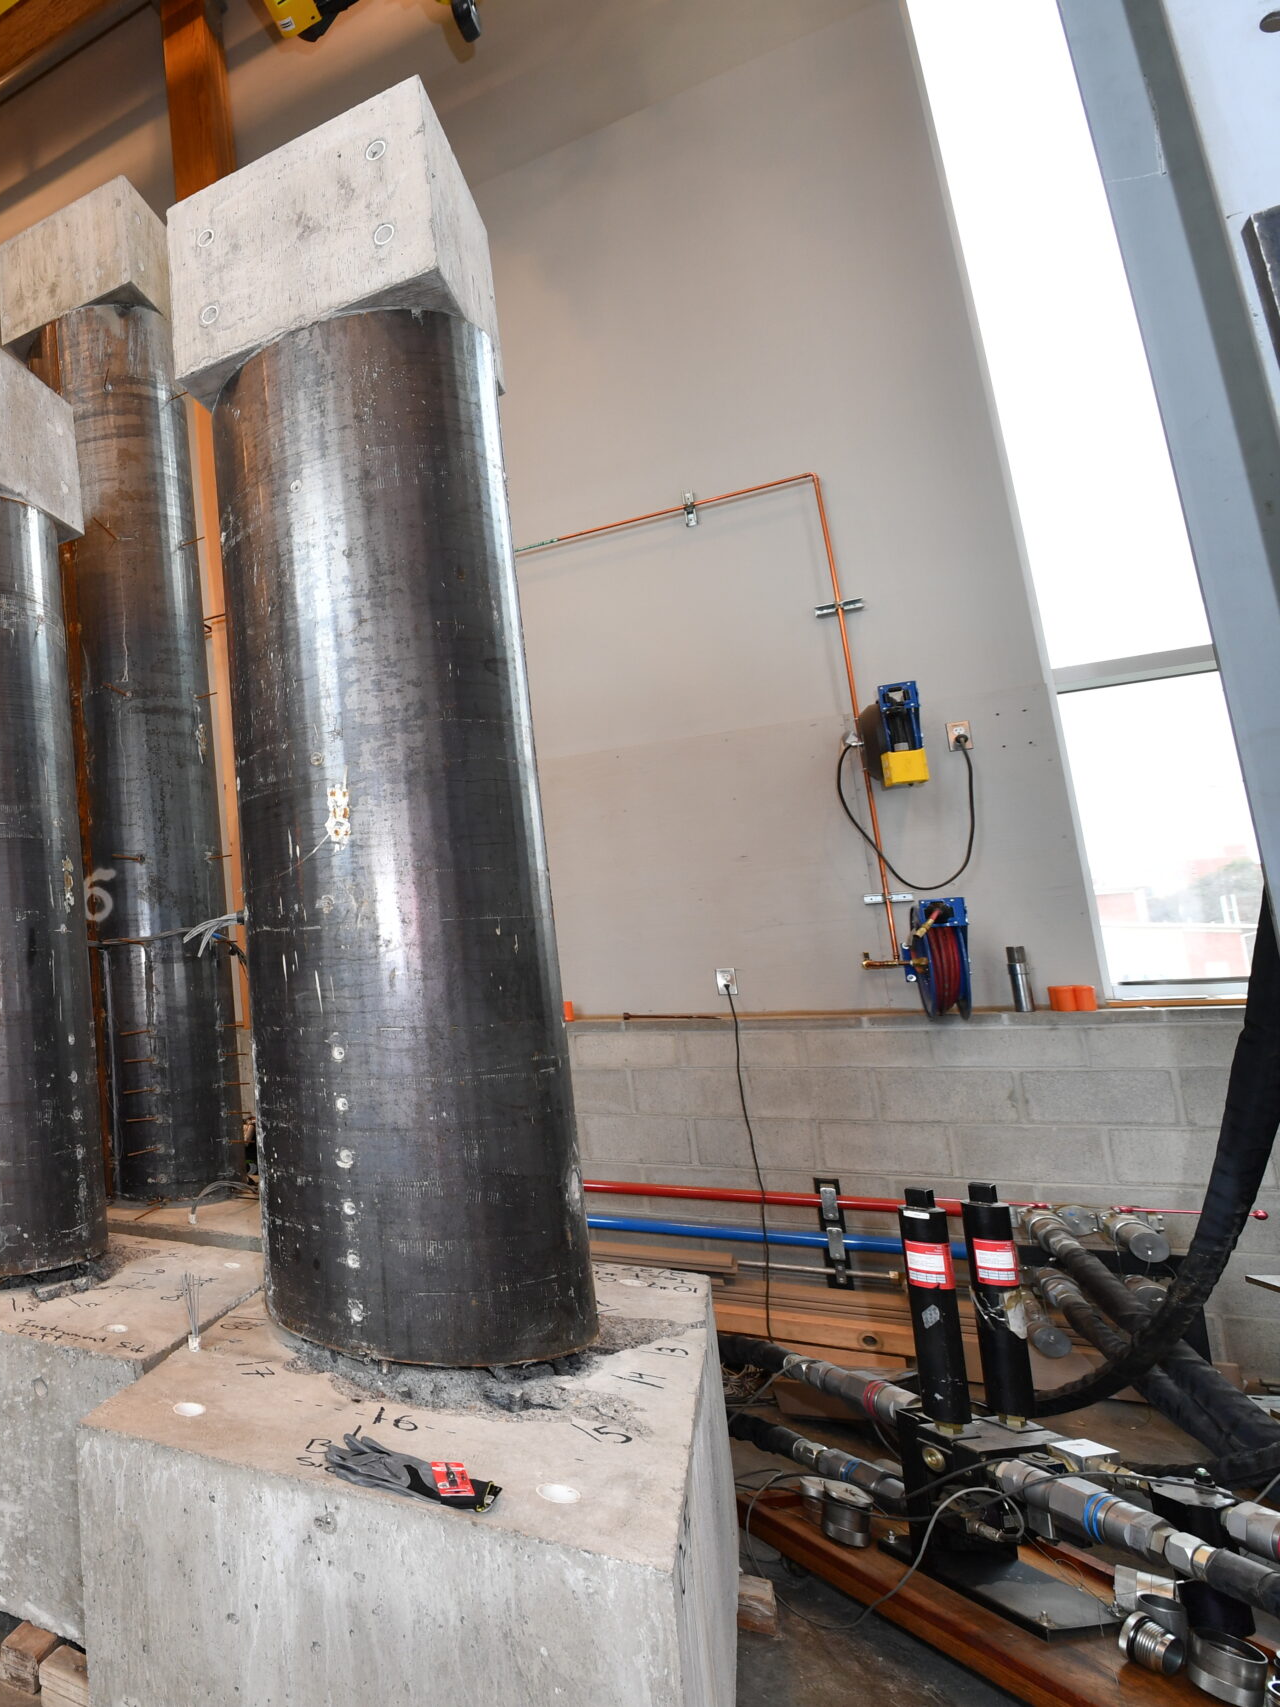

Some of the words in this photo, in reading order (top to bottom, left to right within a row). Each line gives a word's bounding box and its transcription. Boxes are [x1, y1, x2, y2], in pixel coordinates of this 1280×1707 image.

[83, 868, 117, 922] 6
[372, 1406, 418, 1432] 16
[570, 1423, 633, 1444] 15
